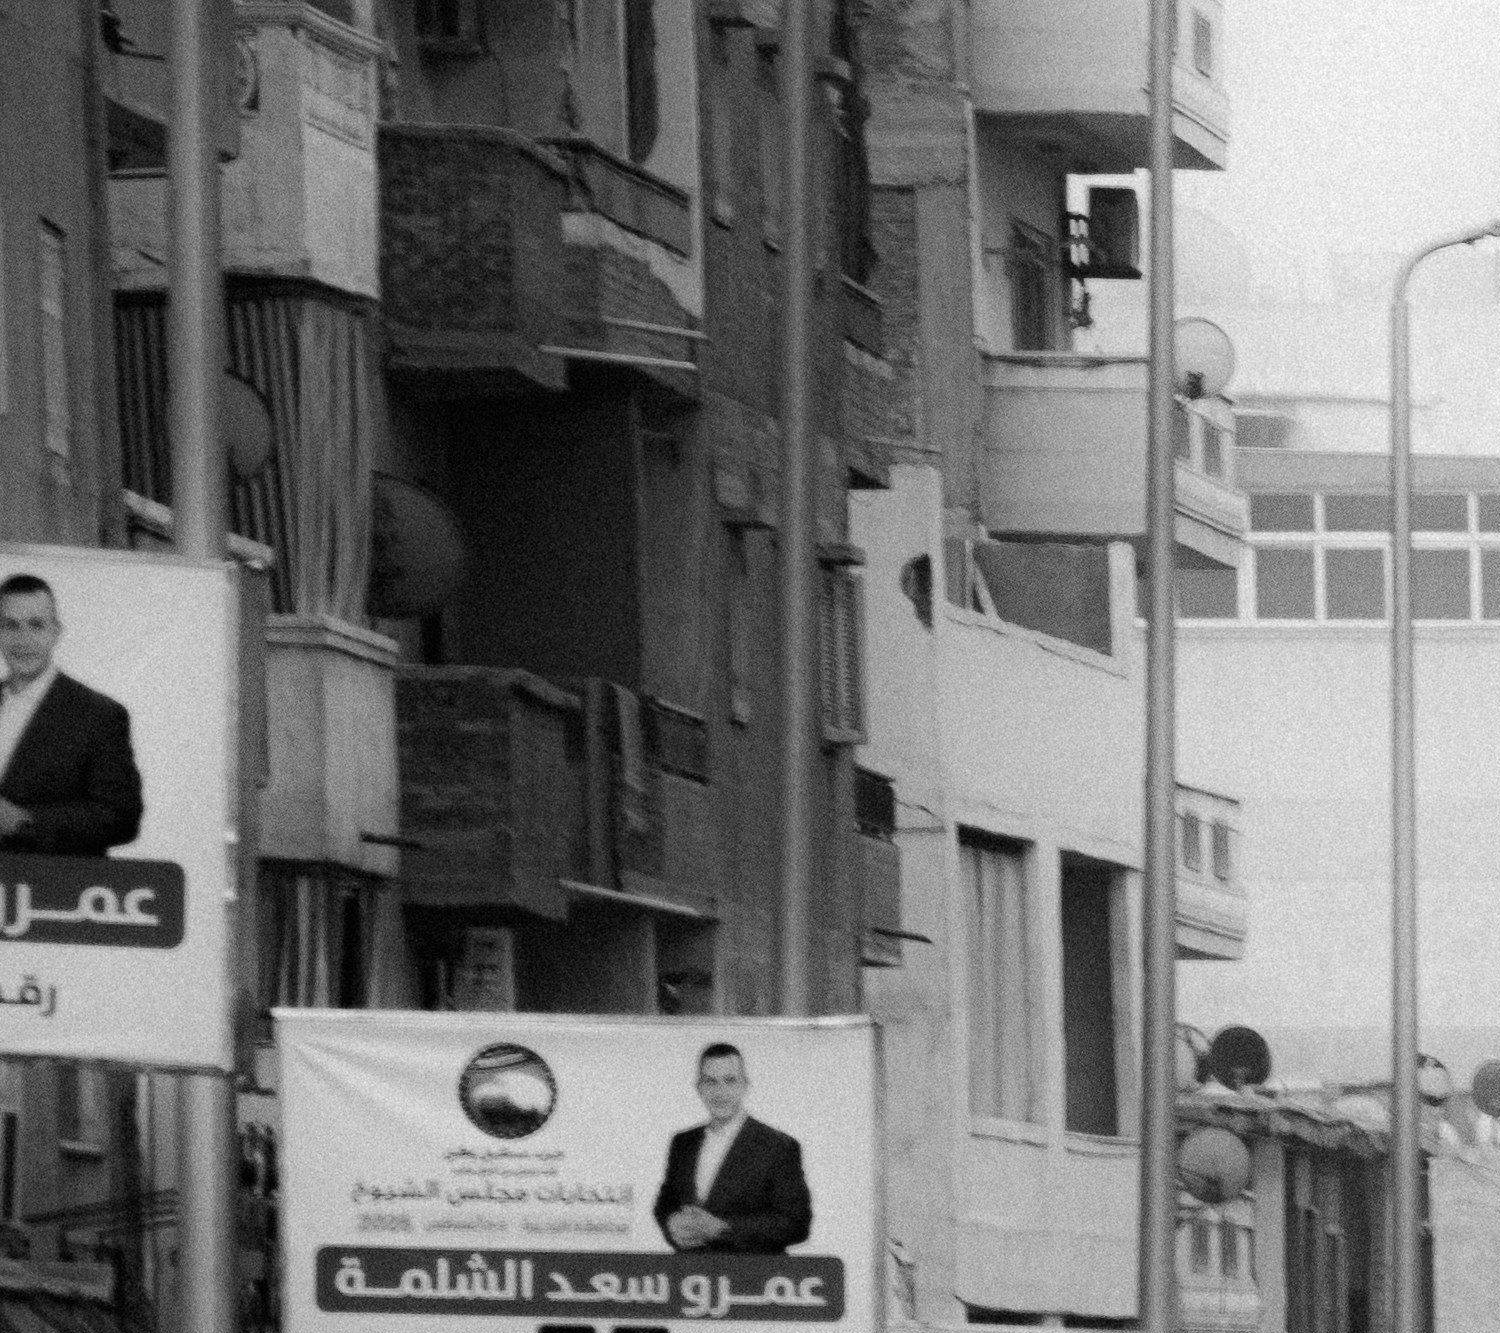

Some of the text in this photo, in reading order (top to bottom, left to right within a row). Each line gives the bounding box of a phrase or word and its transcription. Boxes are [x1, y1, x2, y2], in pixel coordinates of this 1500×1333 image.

[0, 883, 160, 937] عمر
[333, 1252, 828, 1319] عمرو سعد الشلمة
